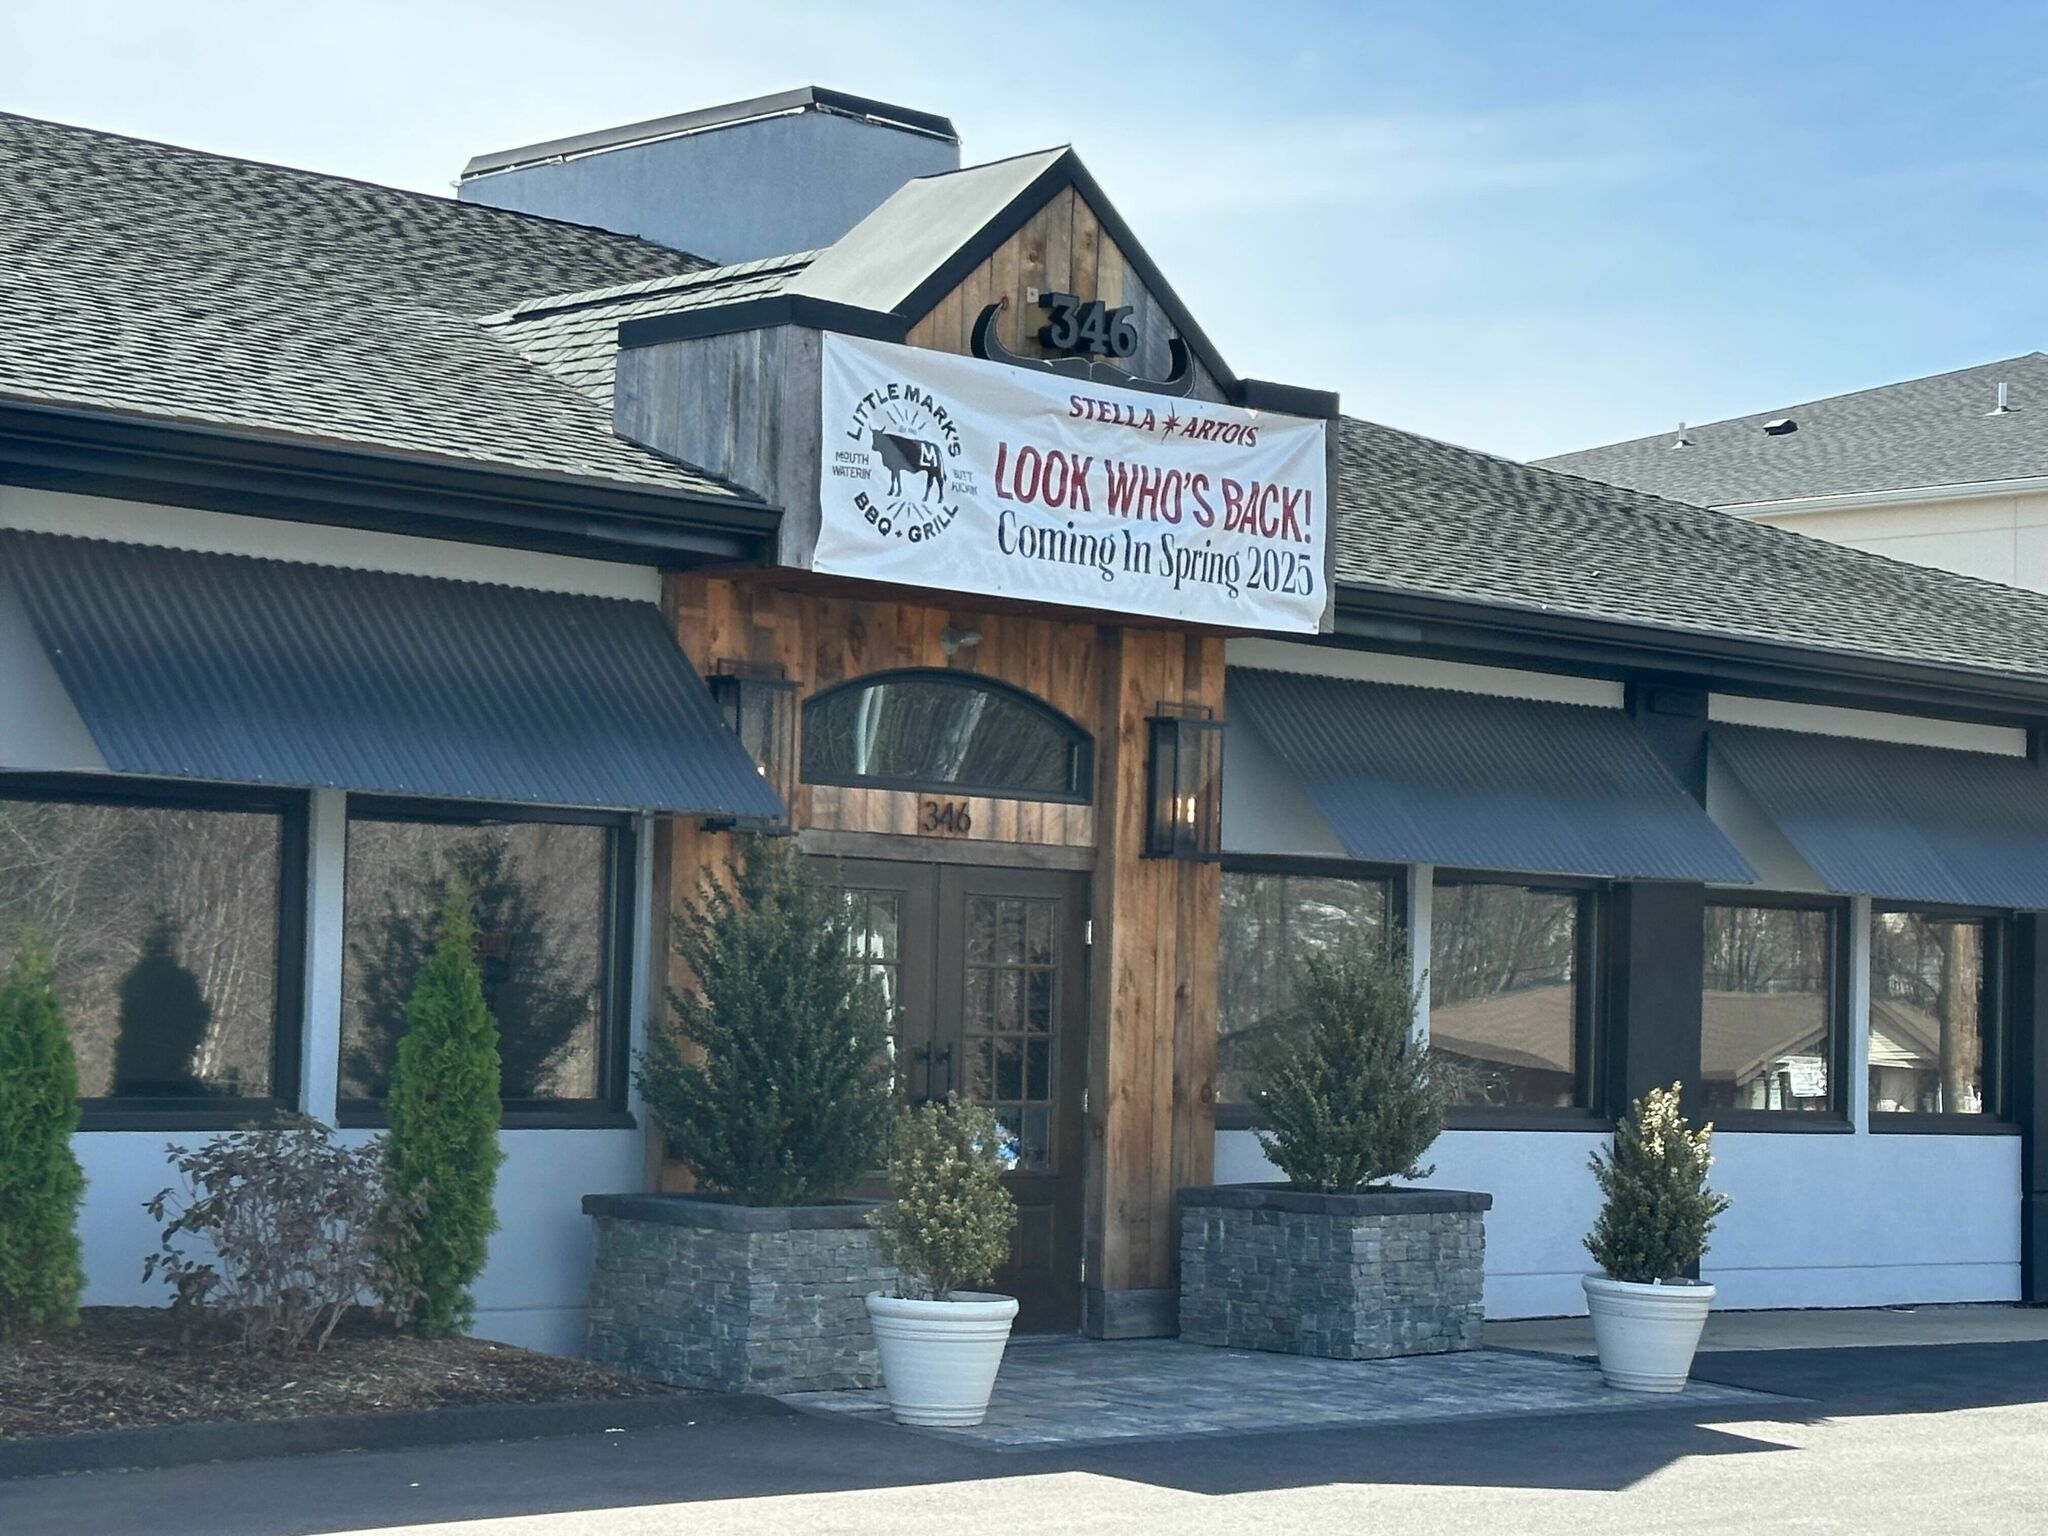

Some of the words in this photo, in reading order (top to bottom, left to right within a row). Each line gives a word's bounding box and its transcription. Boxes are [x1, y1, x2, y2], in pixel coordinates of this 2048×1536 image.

[1040, 292, 1138, 358] 346
[847, 383, 900, 441] LITTLE
[904, 384, 962, 458] MARK'S
[1069, 394, 1156, 432] STELLA
[1179, 416, 1259, 448] ARTOIS
[835, 451, 869, 465] MOUTH
[854, 491, 893, 537] BBQ
[908, 504, 960, 543] GRILL
[995, 441, 1094, 513] LOOK
[1104, 458, 1216, 529] WHO'S
[1222, 477, 1313, 544] BACK!
[997, 510, 1116, 582] Coming
[1122, 529, 1152, 575] In
[1159, 533, 1241, 599] Spring
[1247, 546, 1314, 597] 2025
[923, 801, 971, 833] 346
